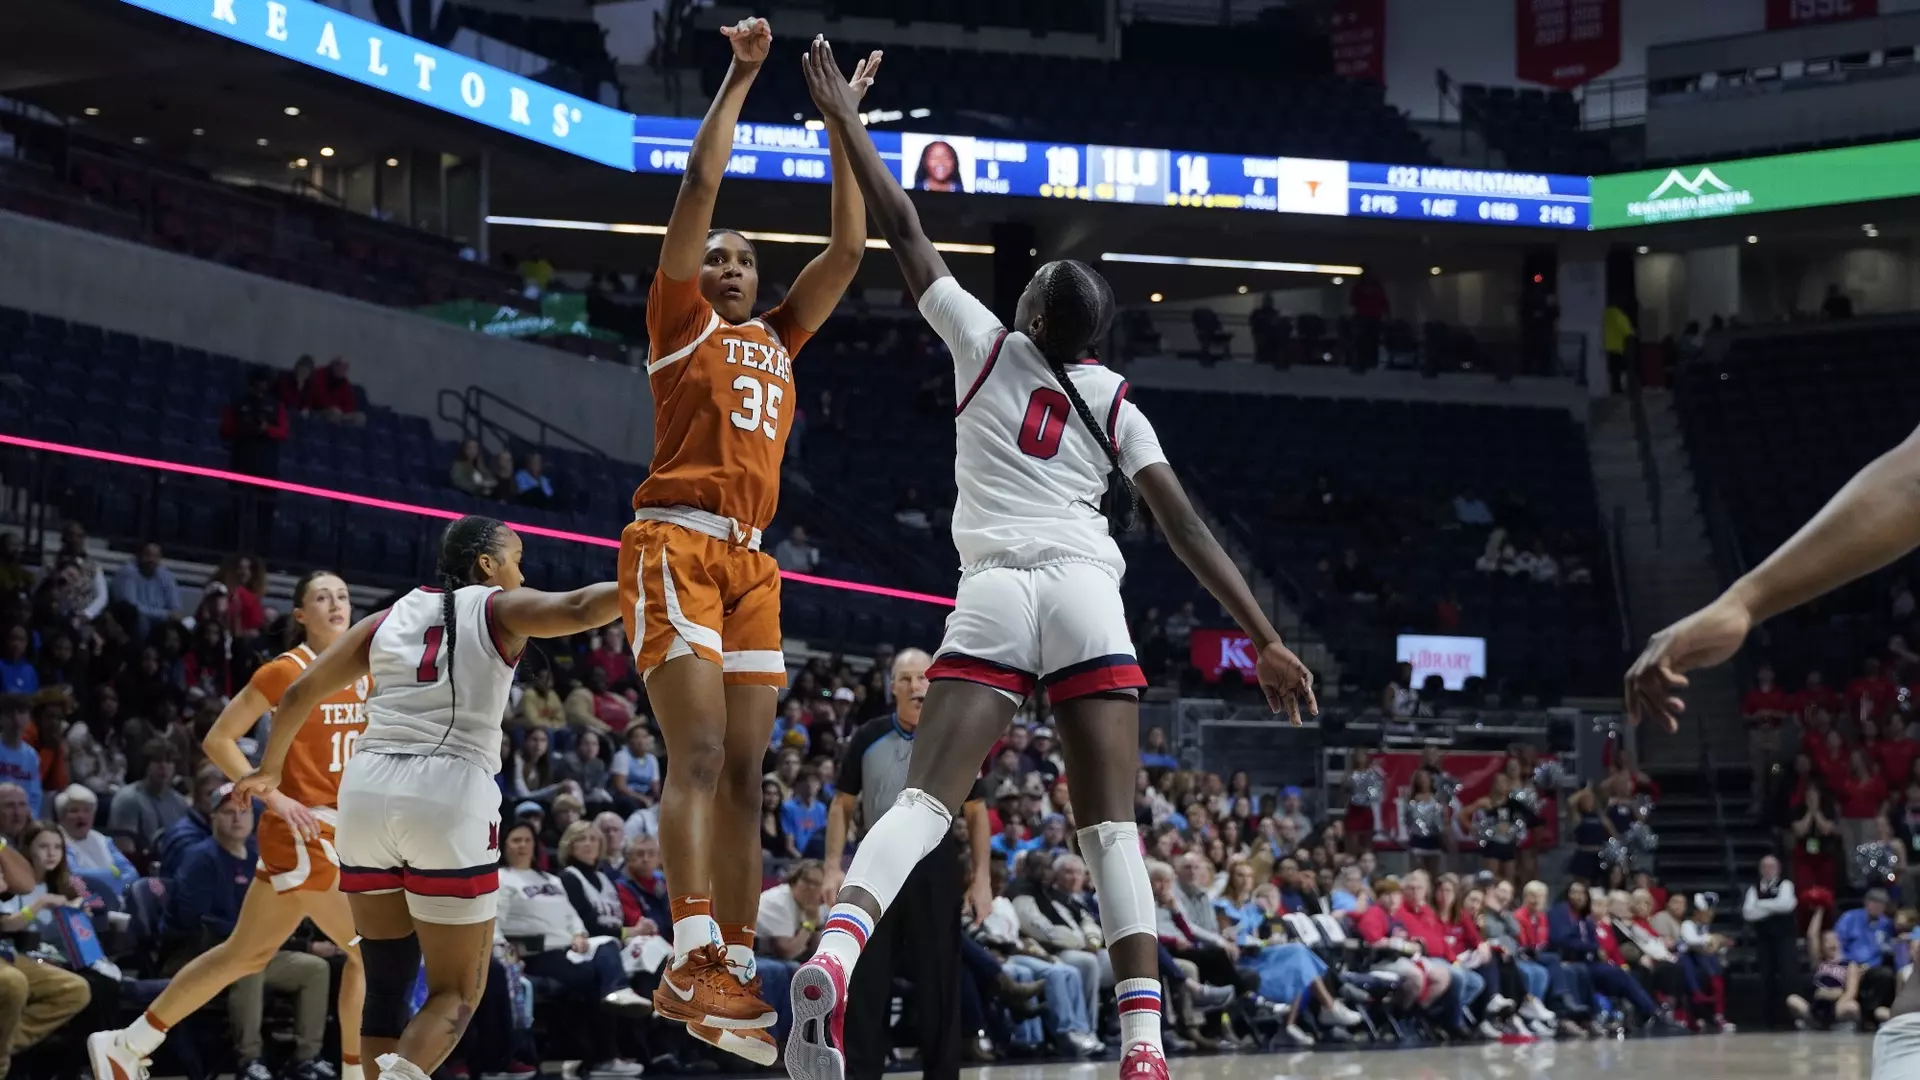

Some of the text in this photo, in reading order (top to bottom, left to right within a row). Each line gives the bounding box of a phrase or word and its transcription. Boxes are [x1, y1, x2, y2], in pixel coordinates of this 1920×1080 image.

[1178, 155, 1210, 195] 14
[1372, 195, 1398, 214] PTS
[722, 338, 791, 384] TEXAS
[730, 375, 784, 441] 35
[1017, 386, 1072, 461] 0
[416, 625, 445, 683] 1
[320, 702, 368, 725] TEXA
